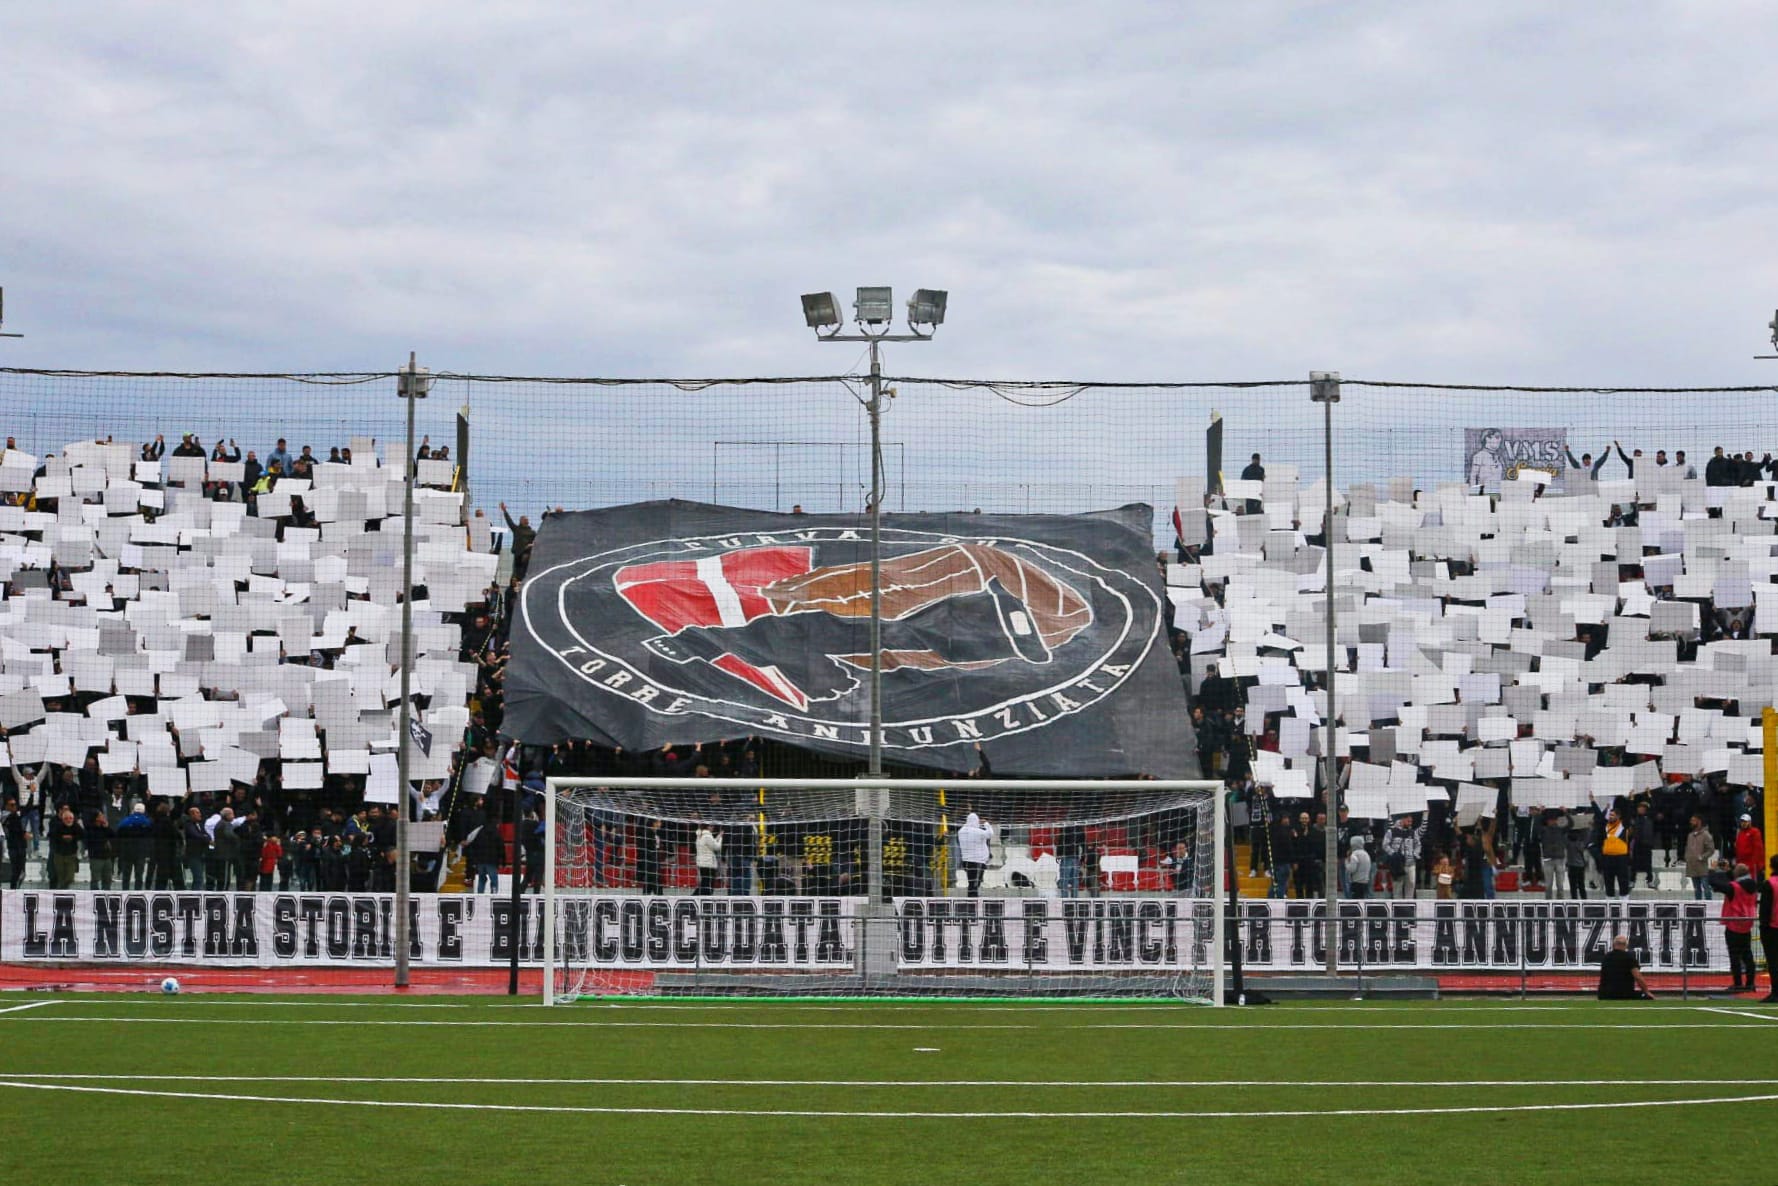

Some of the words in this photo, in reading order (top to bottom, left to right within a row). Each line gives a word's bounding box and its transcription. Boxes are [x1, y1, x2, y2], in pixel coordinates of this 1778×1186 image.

[684, 530, 862, 551] CURVA
[559, 646, 693, 713] TORRE
[763, 663, 1132, 747] ANNUNZIATA
[23, 893, 79, 957] LA
[93, 894, 260, 959] NOSTRA
[273, 896, 423, 961] STORIA
[895, 899, 1009, 965] OTTA
[1022, 900, 1048, 965] E
[1062, 900, 1178, 965] VINCI
[1431, 902, 1711, 968] ANNUNZIATA
